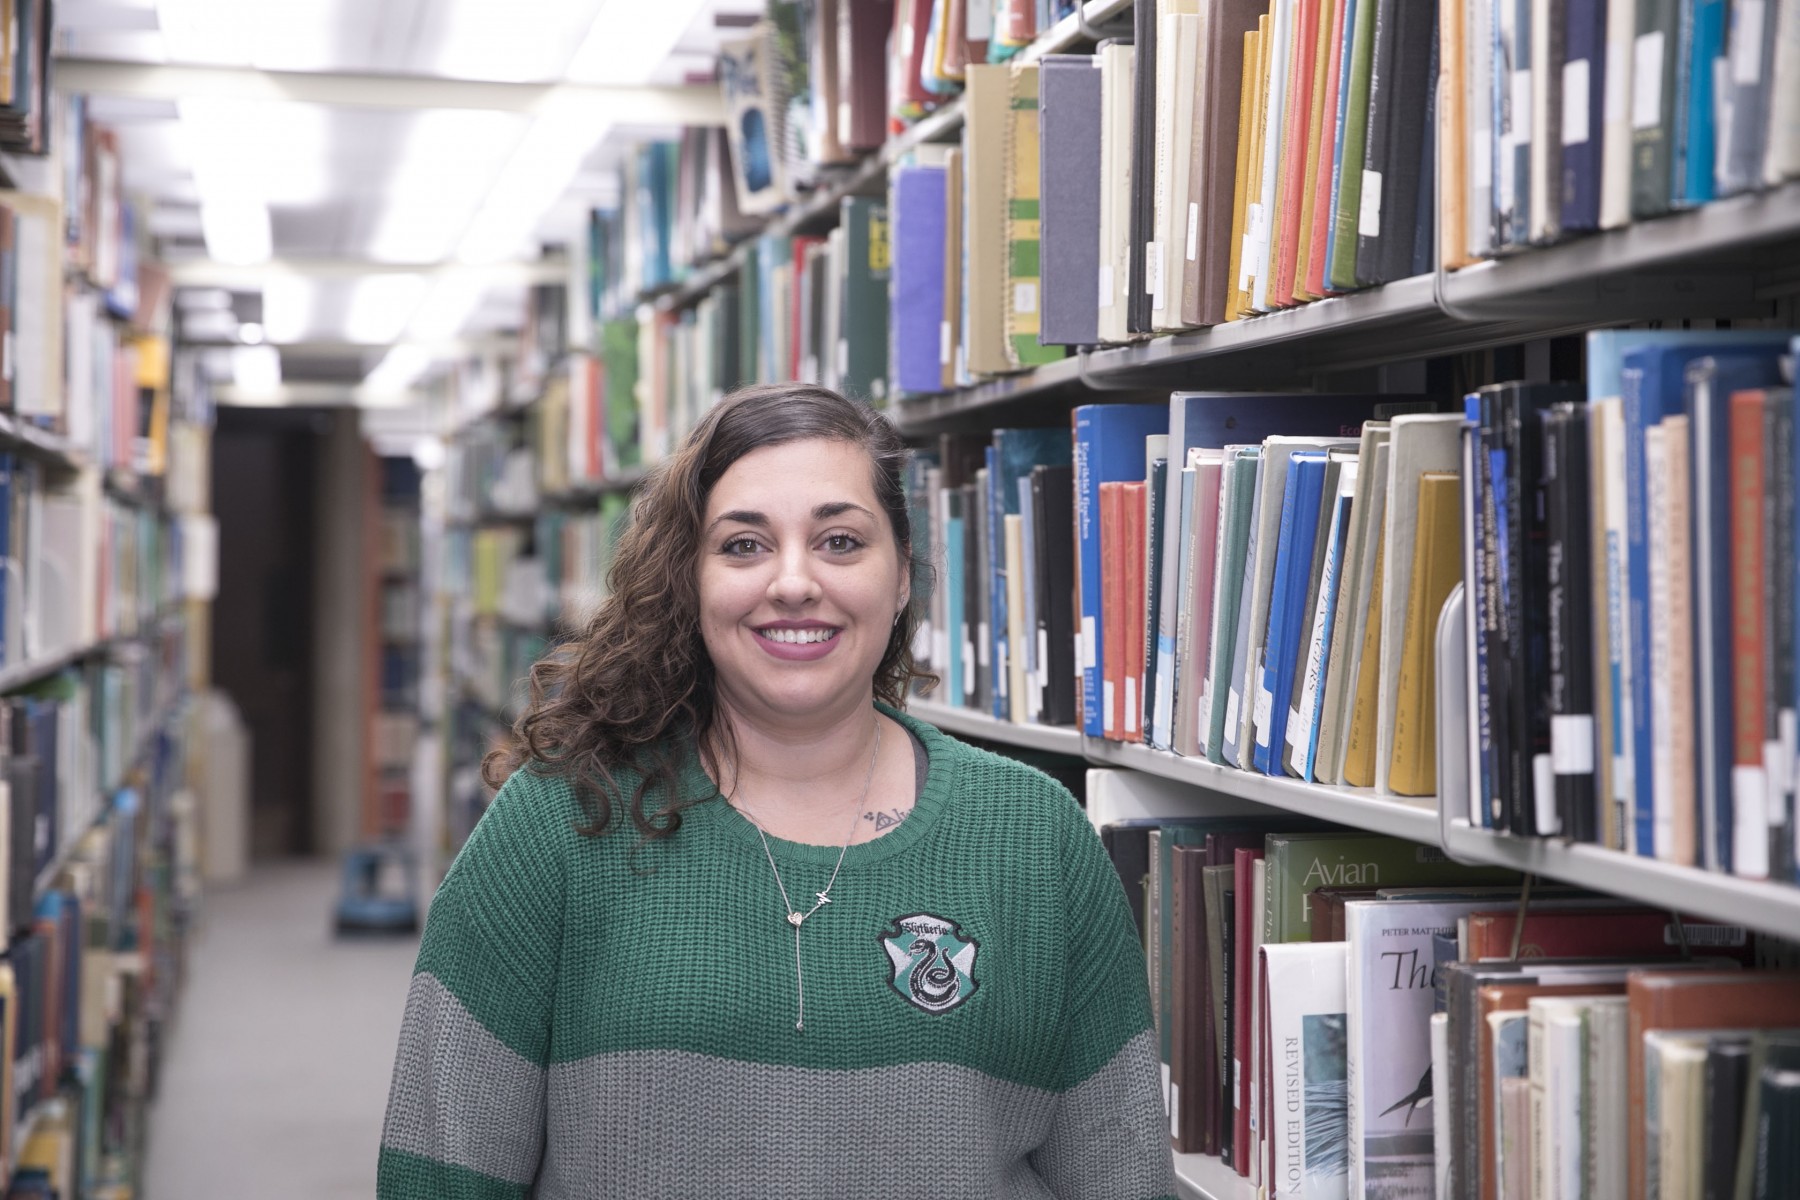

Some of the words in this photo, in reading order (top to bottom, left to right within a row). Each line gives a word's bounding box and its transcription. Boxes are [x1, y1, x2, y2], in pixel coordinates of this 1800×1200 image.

[1366, 101, 1377, 158] Common
[1082, 496, 1090, 539] finches
[1550, 540, 1562, 583] The
[1307, 595, 1330, 691] TANAGERS
[1480, 692, 1490, 751] BATS
[1303, 856, 1380, 886] Avian
[902, 922, 948, 936] Slytherin
[1382, 927, 1410, 936] PETER
[1285, 1036, 1300, 1113] REVISED
[1287, 1120, 1302, 1195] EDITION
